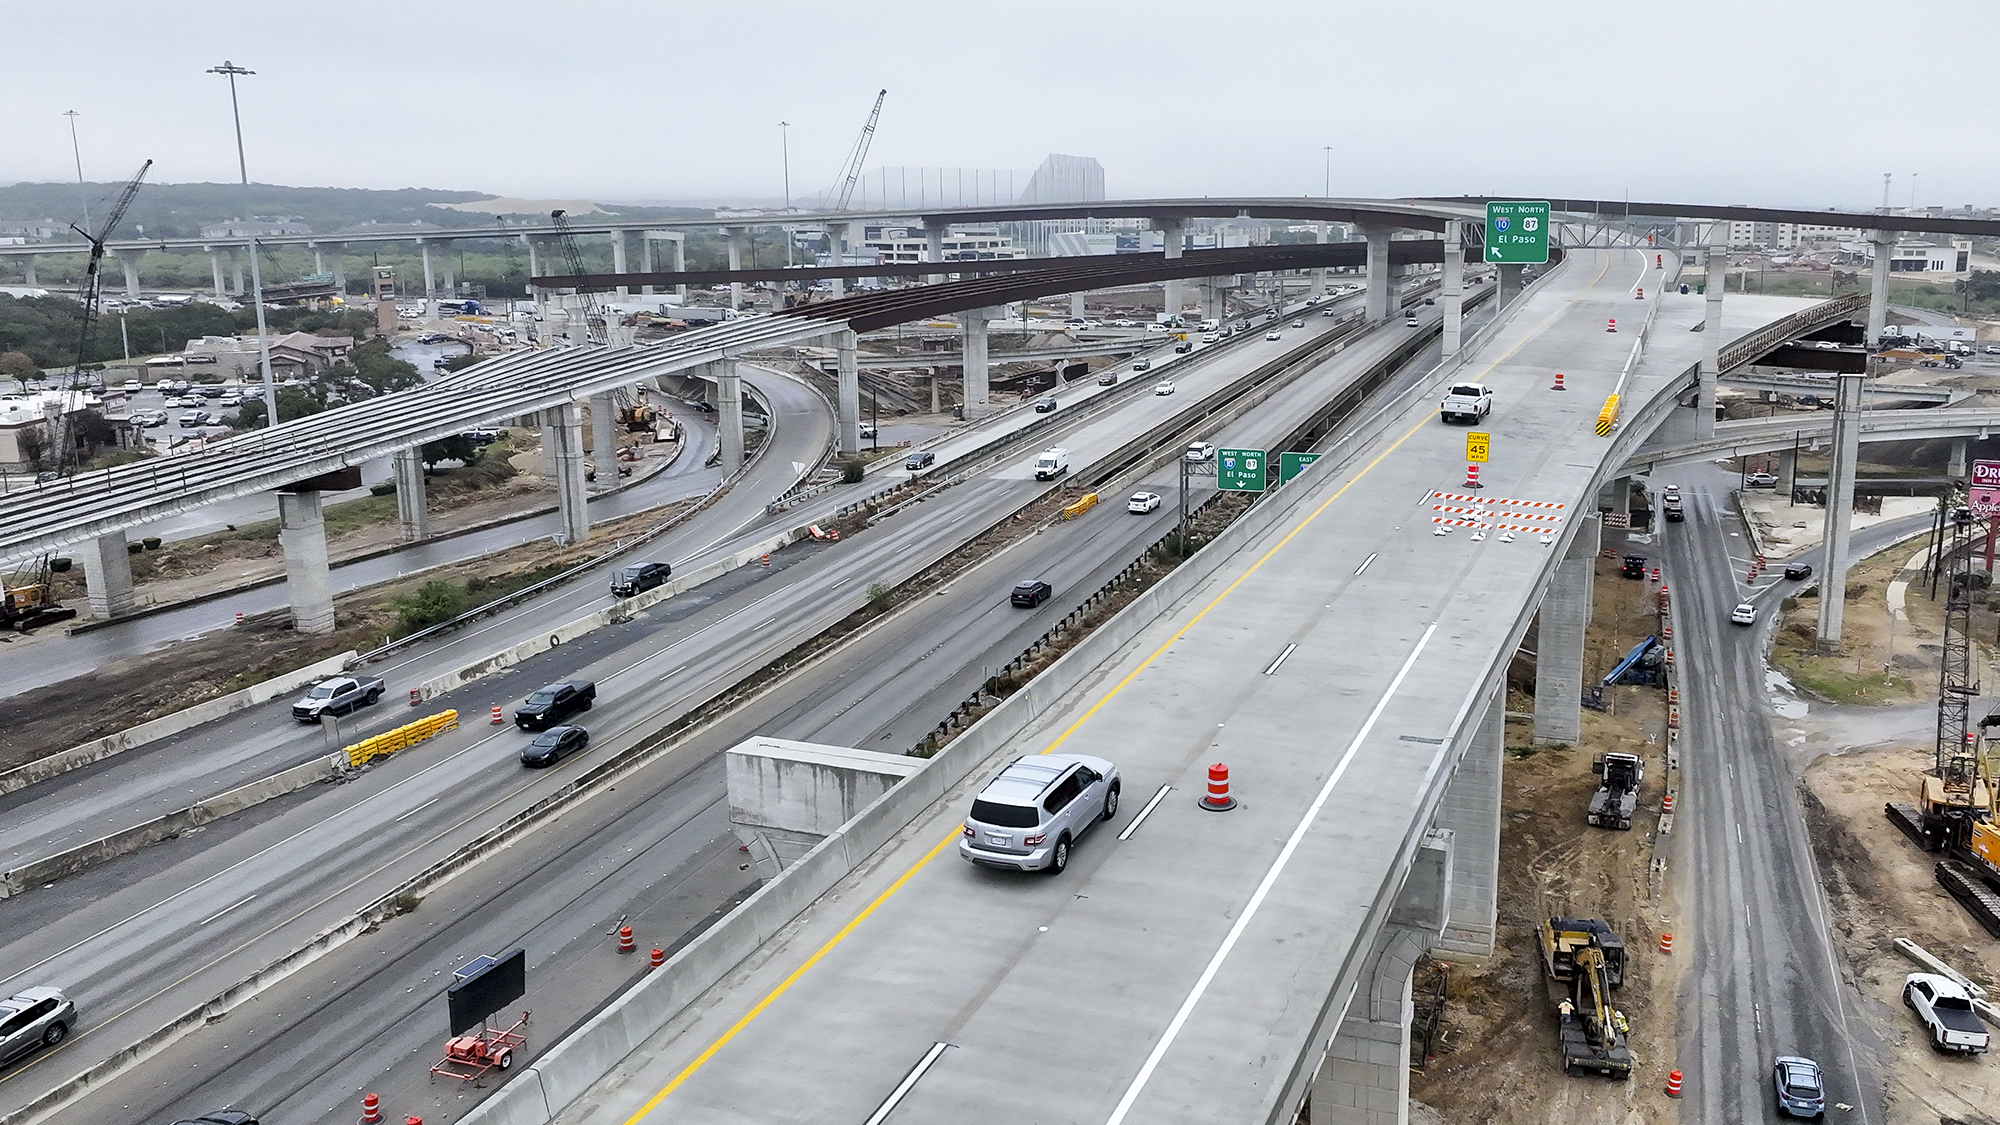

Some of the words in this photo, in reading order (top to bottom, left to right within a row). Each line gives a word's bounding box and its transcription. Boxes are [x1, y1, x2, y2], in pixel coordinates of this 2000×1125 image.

[1498, 221, 1507, 229] 10
[1525, 220, 1536, 228] 87
[1498, 235, 1508, 243] El
[1512, 235, 1536, 243] Paso
[1470, 445, 1485, 454] 45
[1246, 460, 1256, 468] 87
[1970, 500, 2000, 513] Apple
